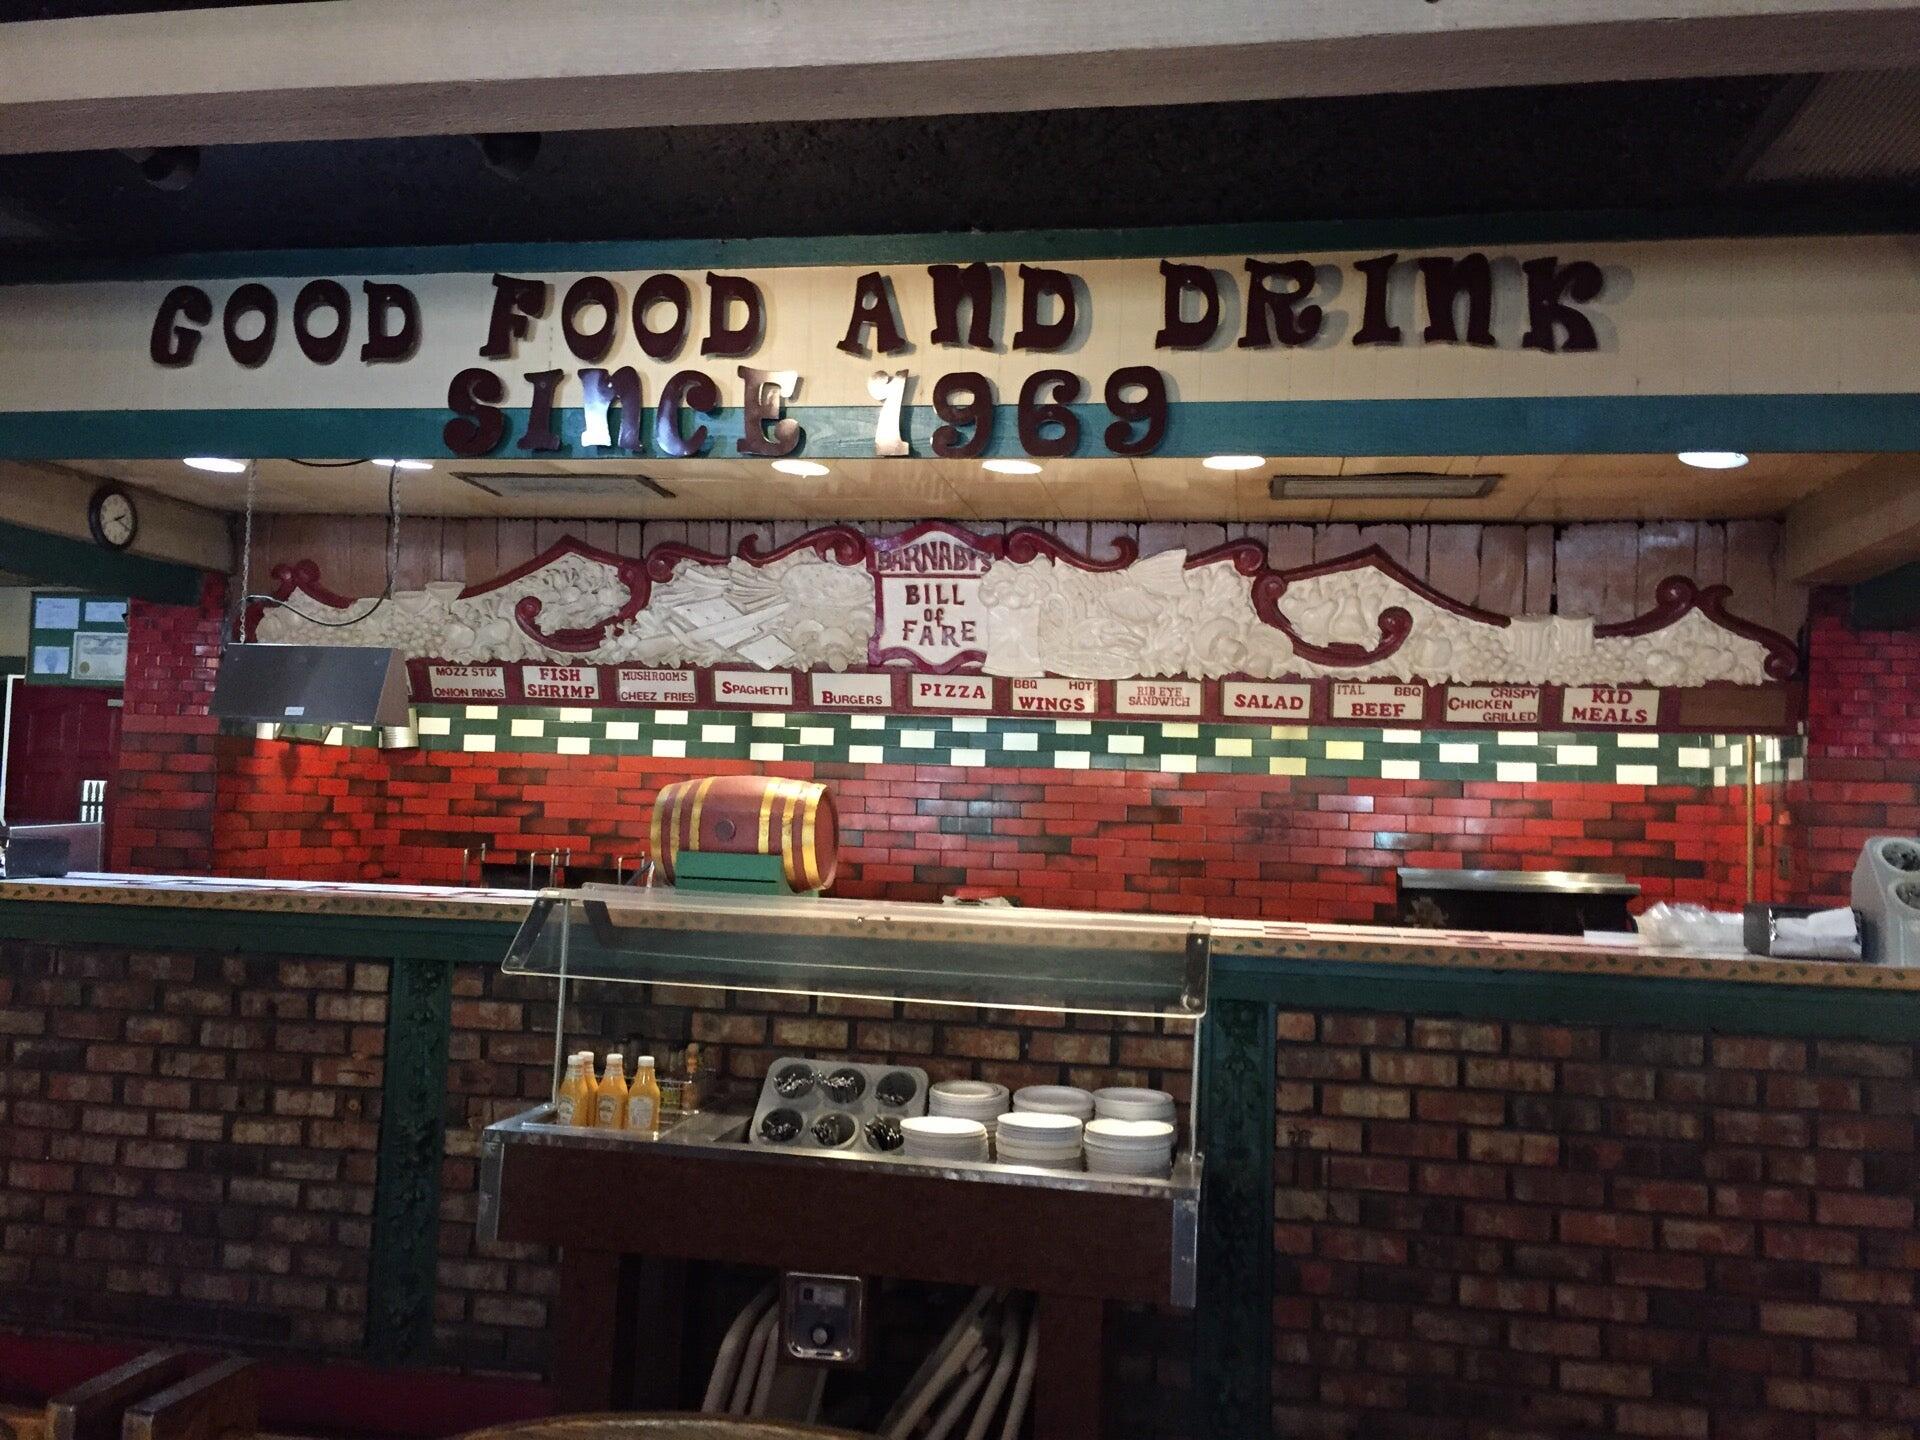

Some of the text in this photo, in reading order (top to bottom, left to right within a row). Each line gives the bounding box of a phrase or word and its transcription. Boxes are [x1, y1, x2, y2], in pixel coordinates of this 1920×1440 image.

[150, 252, 1605, 368] GOOD FOOD AND DRINK
[443, 365, 1170, 458] SINCE 1969
[905, 584, 965, 605] BILL
[902, 620, 976, 647] FARE
[436, 667, 497, 677] MOZZ STIX
[539, 668, 581, 682] FISH
[622, 671, 688, 682] MUSHROOMS
[434, 687, 504, 698] ONION RINGS
[527, 683, 595, 699] SHRIMP
[919, 683, 986, 700] PIZZA
[1014, 679, 1093, 692] BBQ HOT
[1137, 686, 1183, 697] RIB EYE
[1336, 684, 1422, 698] ITAL BBQ
[621, 691, 695, 702] CHEEZ FRIES
[1490, 688, 1539, 699] CRISPY
[1591, 688, 1634, 706] KID
[1018, 696, 1086, 712] WINGS
[1128, 696, 1190, 707] SANDWICH
[1233, 693, 1304, 710] SALAD
[1350, 702, 1406, 718] BEEF
[1482, 711, 1537, 722] GRILLED
[1571, 706, 1649, 724] MEALS
